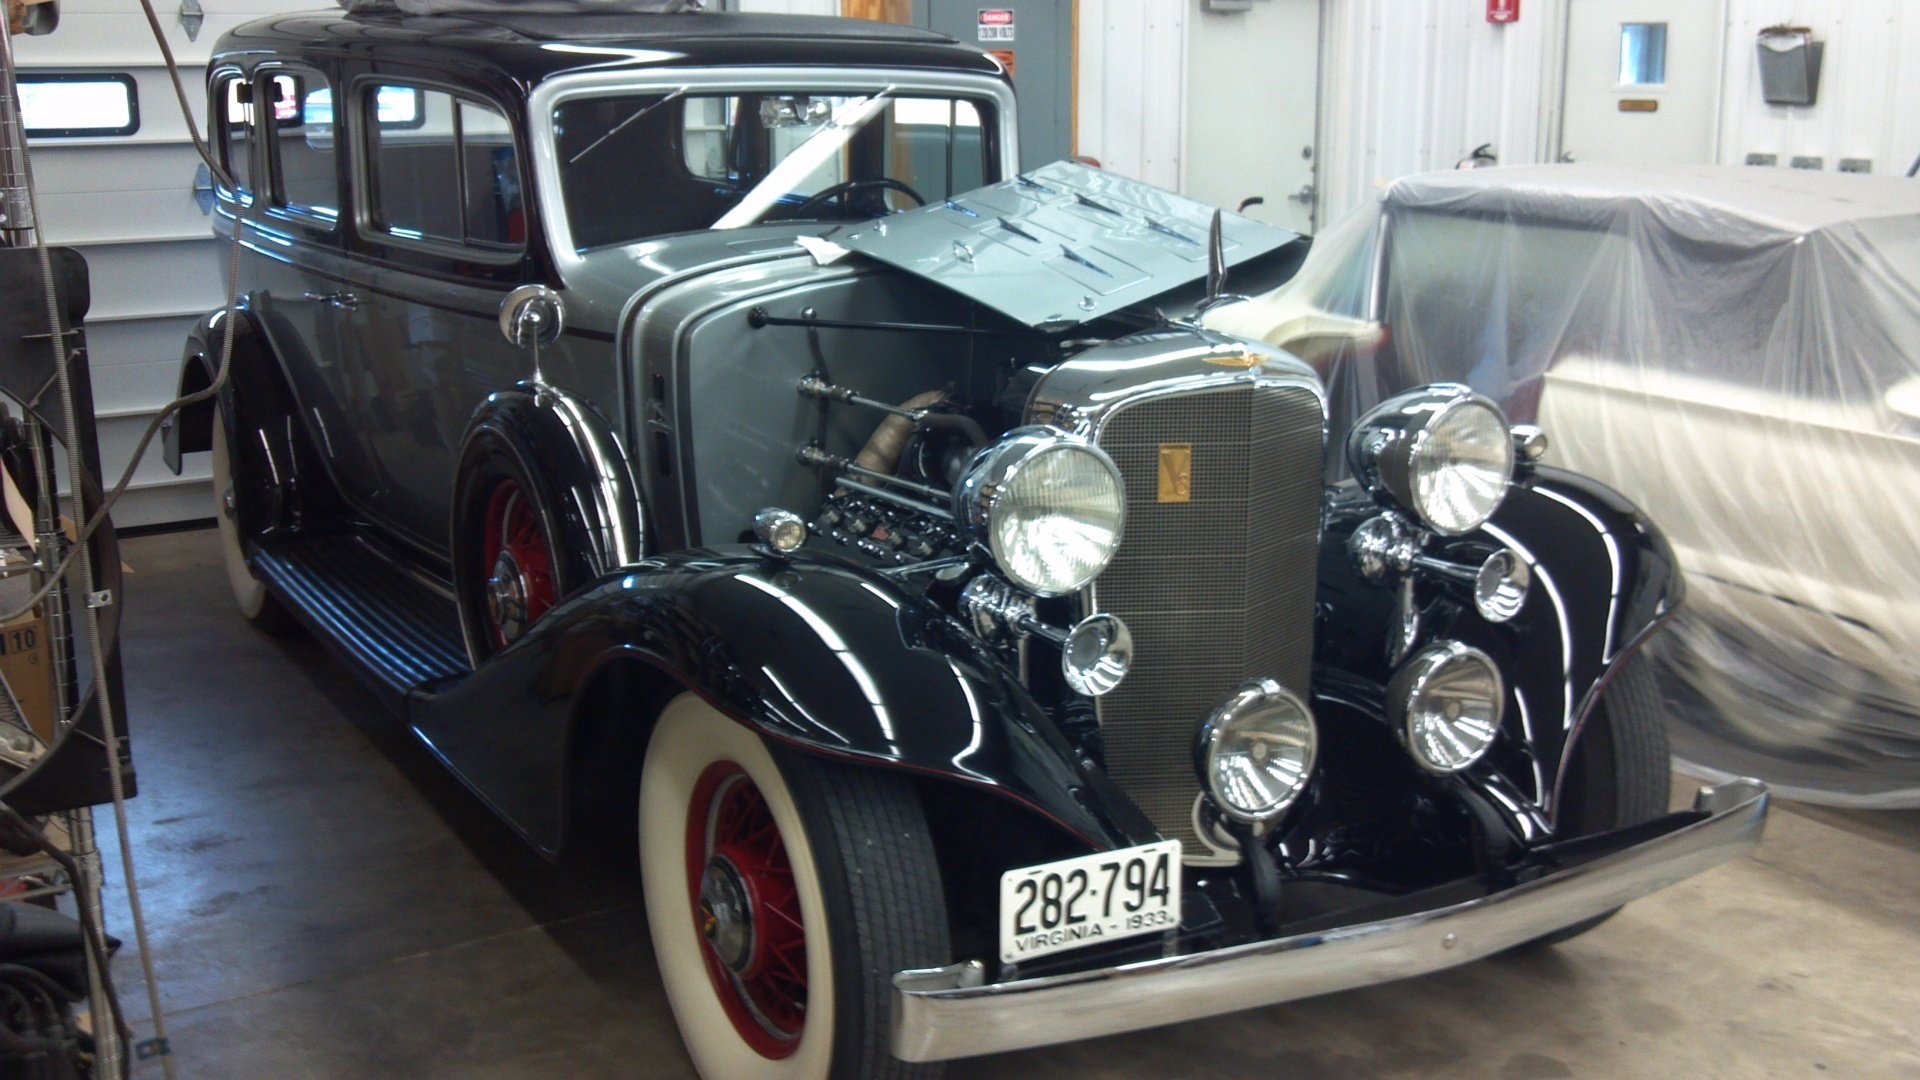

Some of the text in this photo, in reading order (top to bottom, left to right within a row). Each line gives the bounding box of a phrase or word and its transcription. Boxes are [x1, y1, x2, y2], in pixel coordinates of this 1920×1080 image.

[982, 13, 1010, 22] DANGER
[999, 27, 1014, 39] VOLTS
[12, 629, 36, 651] 10
[1015, 923, 1103, 952] VIRGINIA
[1126, 910, 1168, 930] 1933
